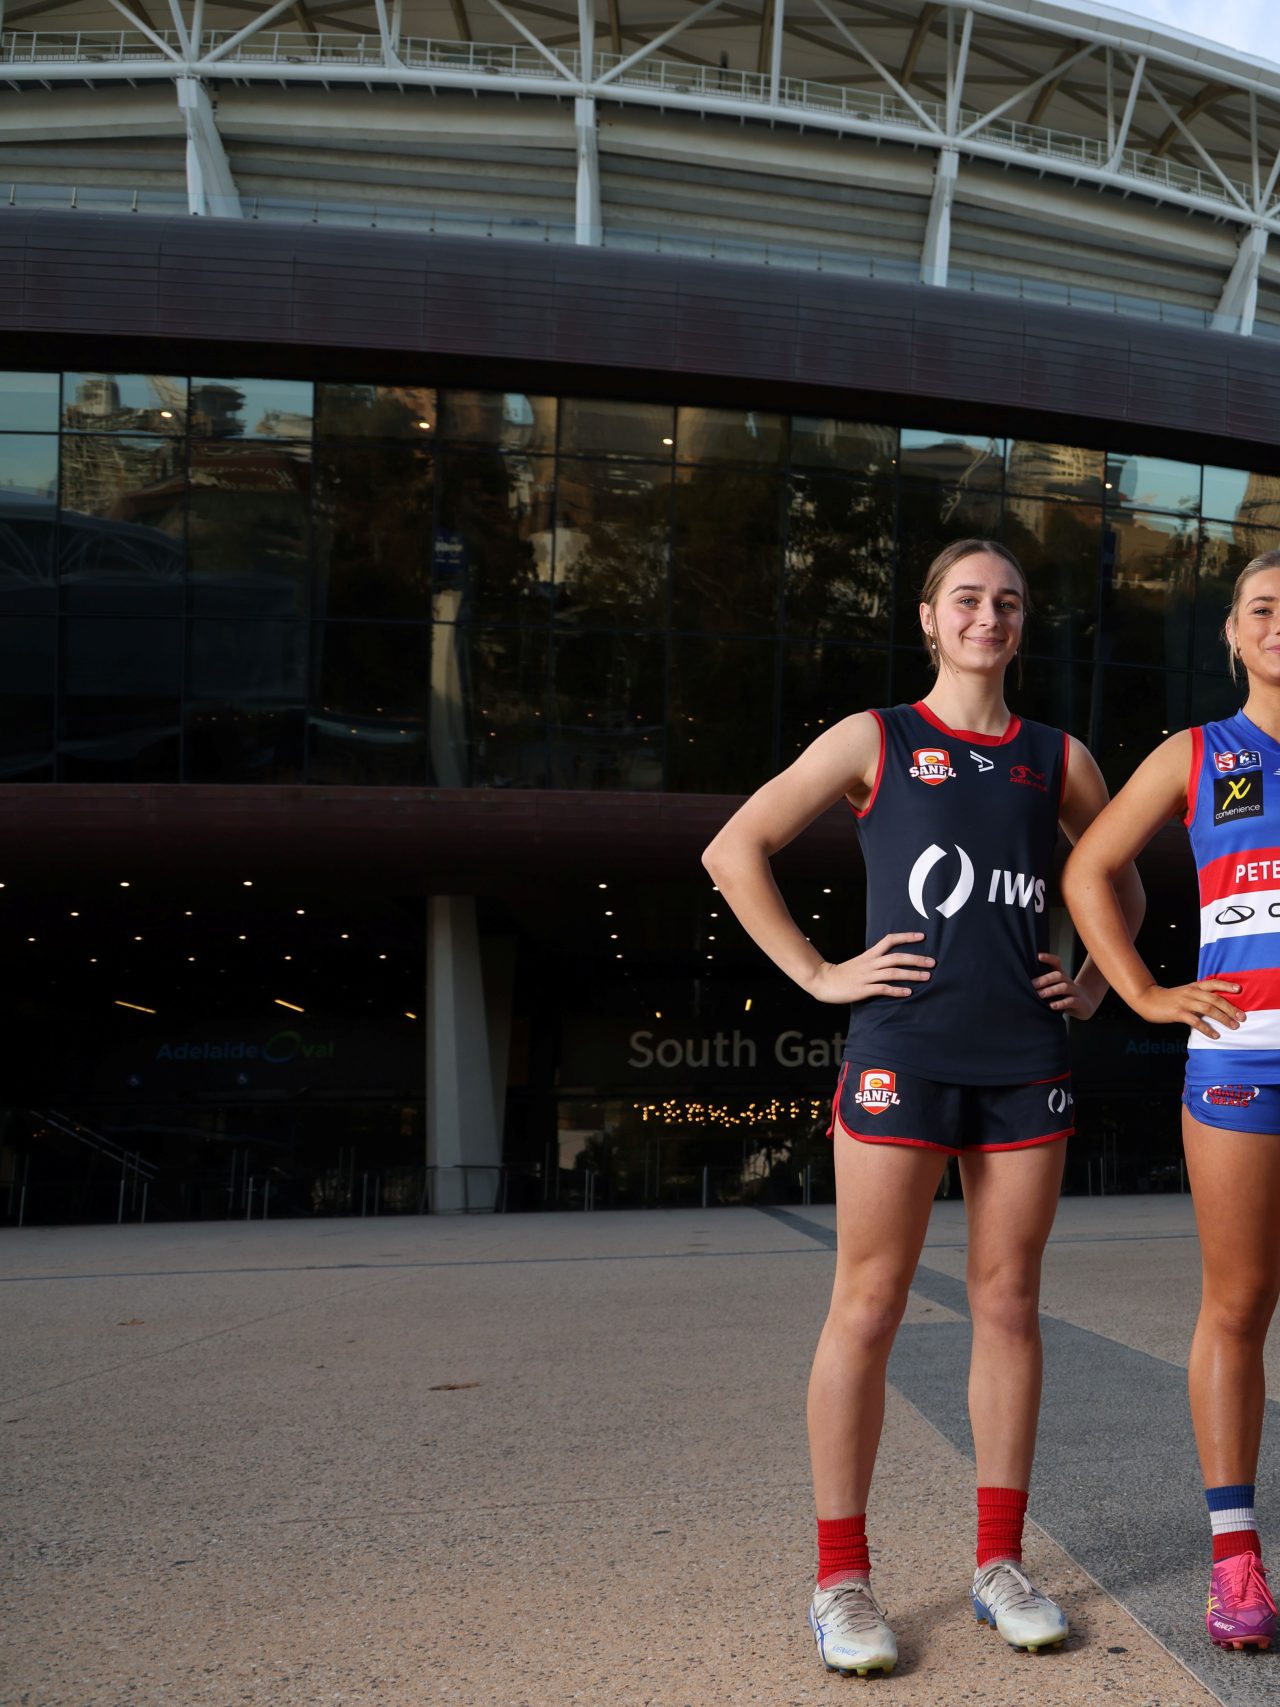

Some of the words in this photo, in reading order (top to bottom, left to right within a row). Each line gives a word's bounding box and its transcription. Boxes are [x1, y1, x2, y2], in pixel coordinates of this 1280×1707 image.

[909, 764, 957, 778] SANFL
[1215, 804, 1260, 820] convenience
[987, 869, 1046, 913] IWS
[155, 1040, 258, 1064] Adelaide
[262, 1029, 335, 1063] Oval
[627, 1029, 757, 1068] South
[774, 1029, 847, 1068] Gat
[854, 1089, 901, 1105] SANFL
